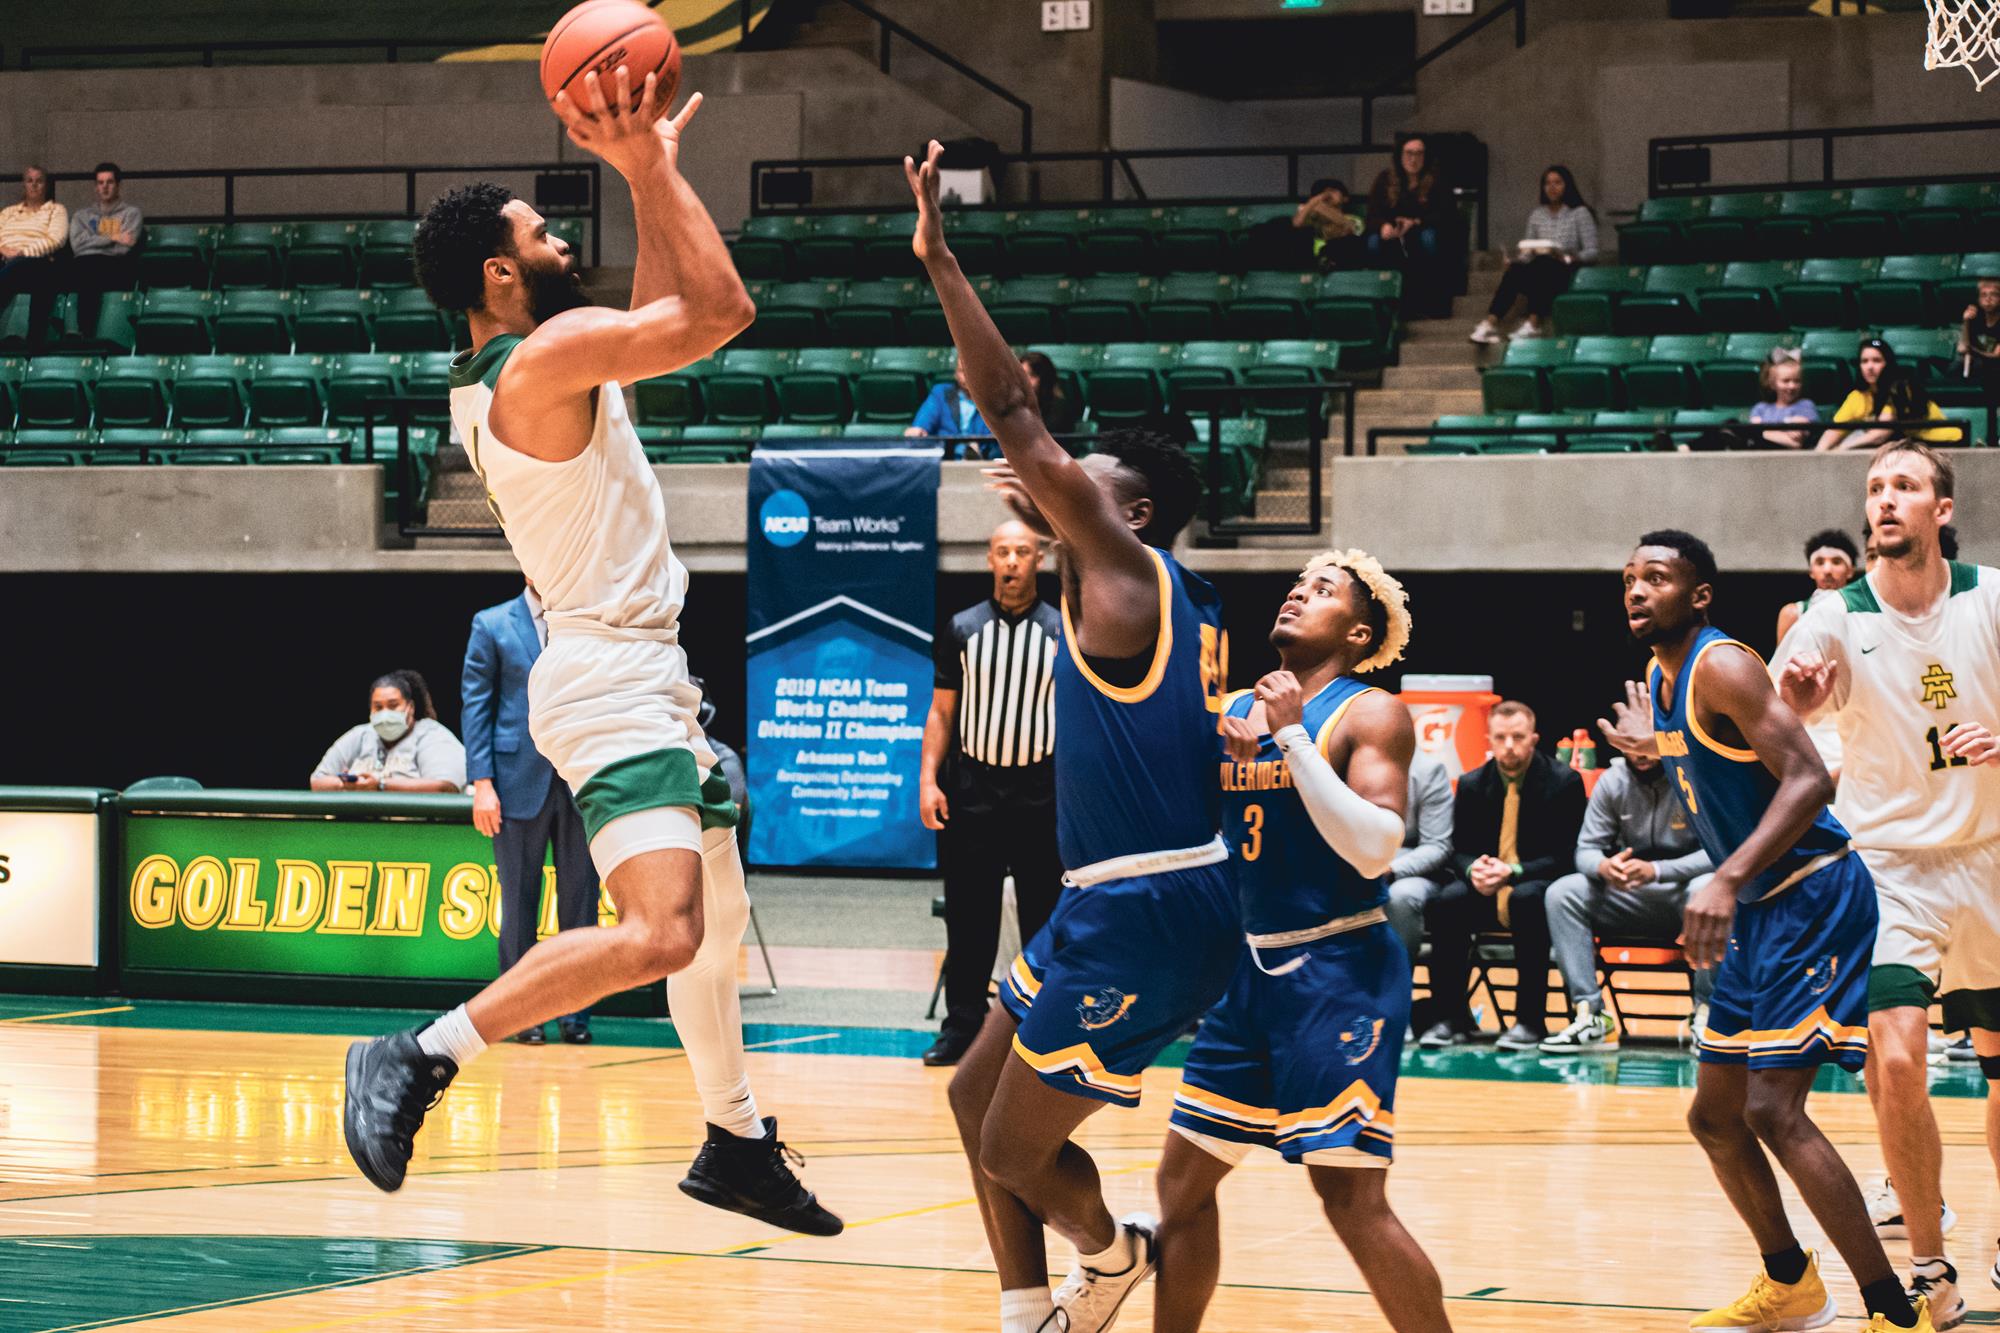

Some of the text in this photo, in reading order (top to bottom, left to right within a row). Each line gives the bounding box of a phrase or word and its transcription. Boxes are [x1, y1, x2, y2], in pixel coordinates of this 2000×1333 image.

[764, 516, 809, 533] NCAA
[814, 516, 851, 533] Team
[775, 678, 908, 698] 2019 NCAA Team
[775, 699, 908, 723] Works Challenge
[757, 719, 924, 744] Division II Champion
[796, 750, 888, 766] Arkansas Tech
[776, 769, 903, 787] Recognizing Outstanding
[792, 785, 889, 800] Community Service
[1242, 804, 1264, 862] 3
[130, 854, 431, 937] GOLDEN
